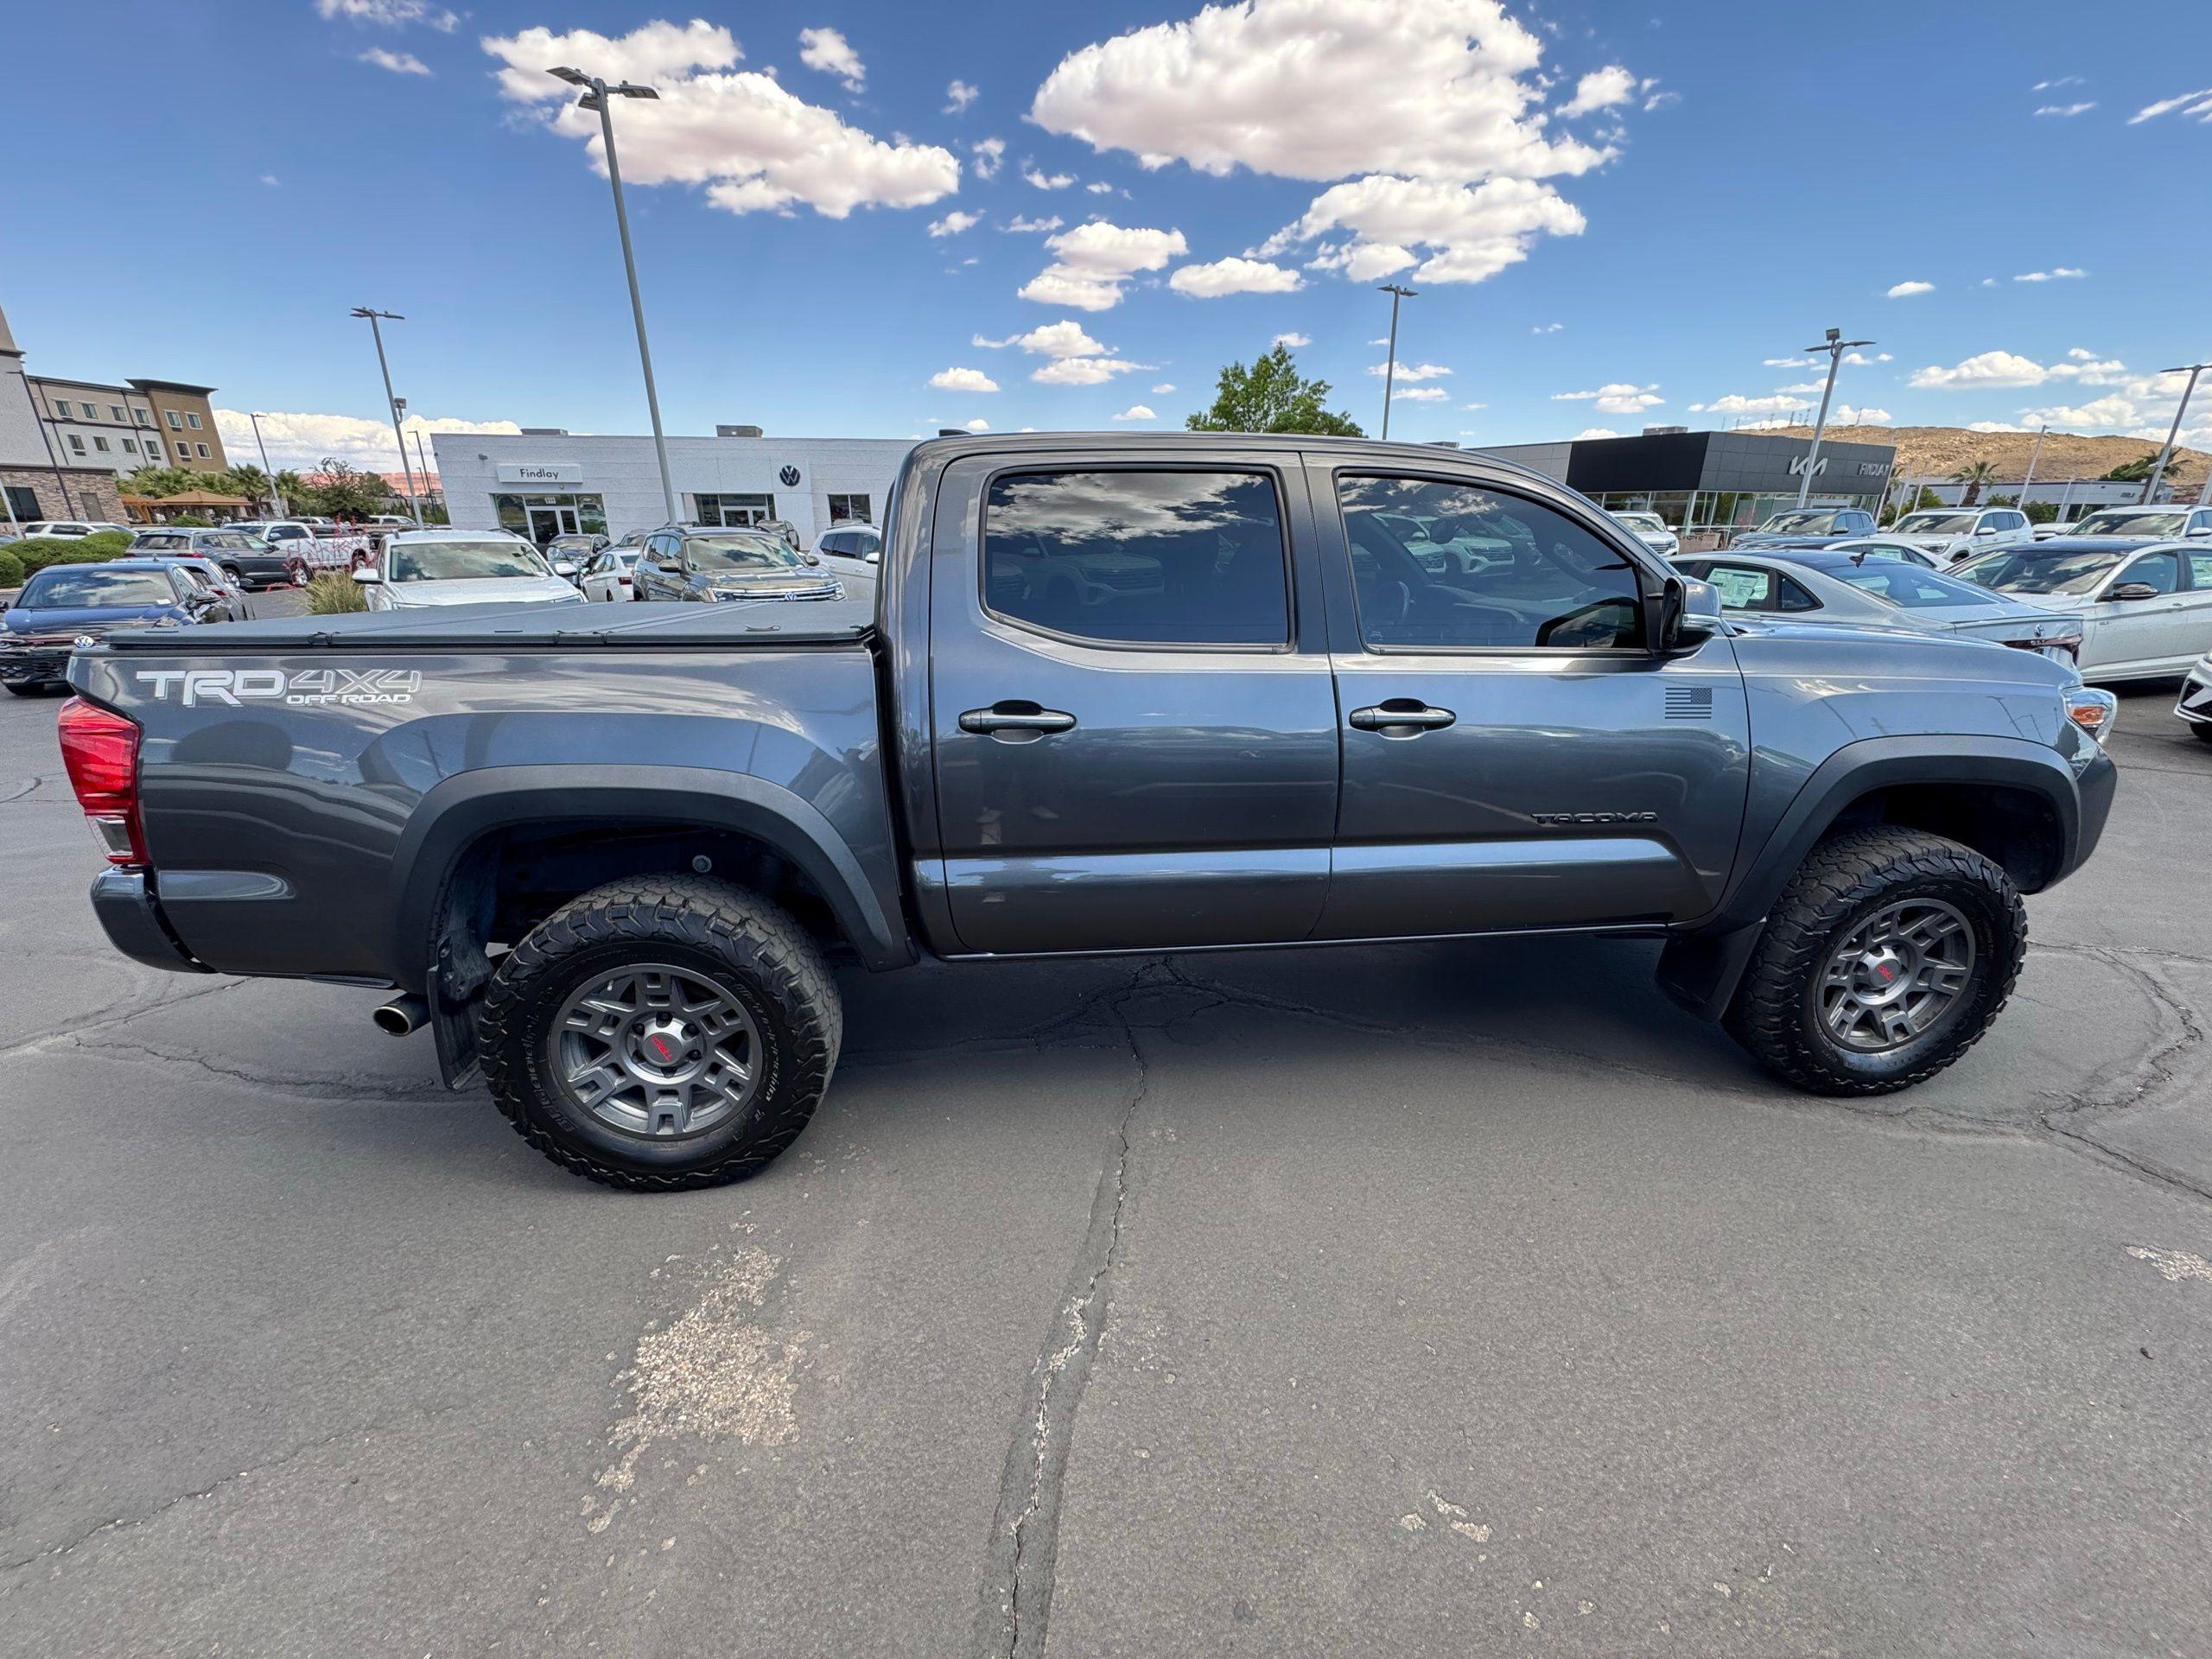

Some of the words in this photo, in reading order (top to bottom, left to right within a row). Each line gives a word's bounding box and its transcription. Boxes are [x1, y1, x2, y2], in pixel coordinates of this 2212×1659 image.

[519, 468, 559, 480] Findlay
[137, 671, 288, 707] TRD
[286, 695, 335, 705] OFF
[340, 694, 414, 705] ROAD
[1532, 811, 1659, 824] TACOMA
